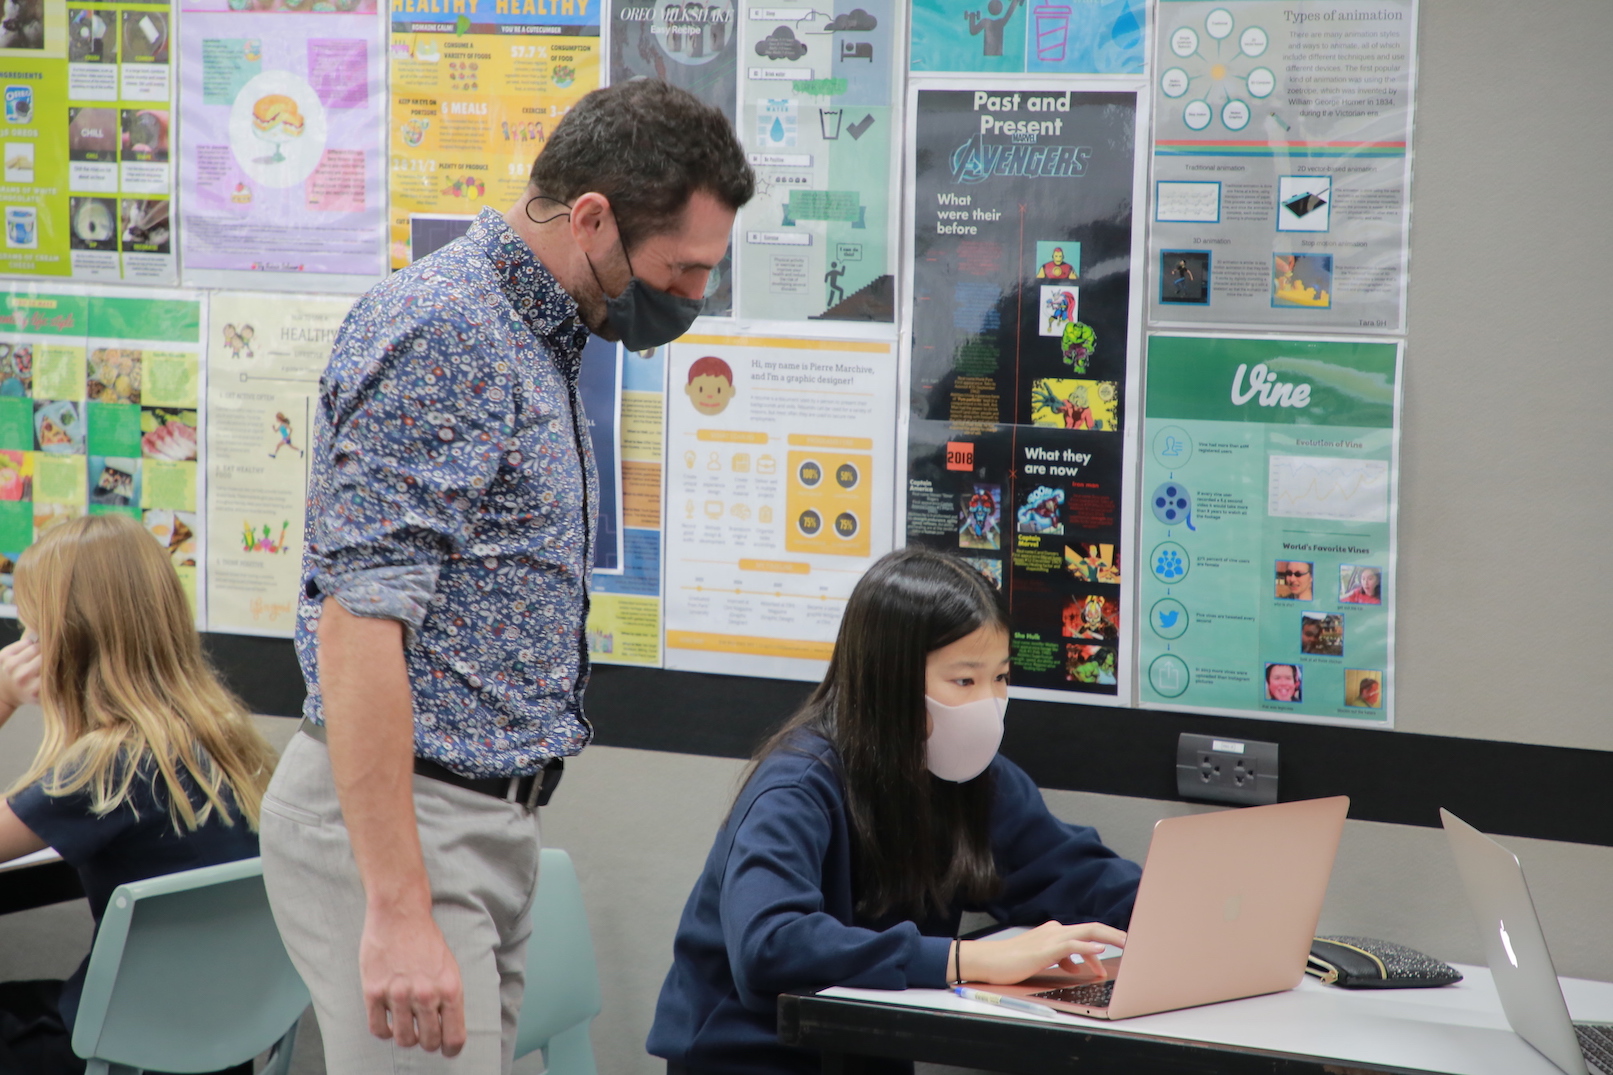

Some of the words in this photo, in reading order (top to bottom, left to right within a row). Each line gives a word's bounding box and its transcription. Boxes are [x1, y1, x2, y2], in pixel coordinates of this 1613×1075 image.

[496, 0, 588, 15] HEALTHY
[620, 8, 655, 21] OREO
[1283, 10, 1320, 24] Types
[1323, 9, 1337, 21] of
[1338, 9, 1403, 21] animation
[651, 25, 670, 36] Easy
[672, 25, 701, 36] Recipe
[1290, 31, 1309, 39] There
[1344, 31, 1378, 39] animation
[1380, 31, 1401, 40] styles
[1309, 53, 1336, 61] different
[1338, 54, 1376, 62] techniques
[1374, 64, 1401, 73] popular
[1388, 88, 1398, 96] by
[974, 91, 1020, 112] Past
[1027, 90, 1070, 112] and
[1315, 98, 1340, 106] George
[441, 102, 448, 114] 6
[451, 102, 488, 114] MEALS
[1300, 110, 1322, 118] during
[1336, 110, 1366, 118] Victorian
[980, 115, 1062, 136] Present
[81, 128, 104, 138] CHILL
[1012, 133, 1037, 144] MARVEL
[949, 133, 1093, 185] AVENGERS
[937, 193, 972, 206] What
[937, 210, 968, 221] were
[972, 208, 1002, 222] their
[937, 222, 978, 236] before
[1302, 240, 1315, 248] Stop
[1358, 320, 1374, 328] Tara
[281, 327, 338, 342] HEALTHY
[751, 360, 764, 370] Hi,
[764, 362, 776, 371] my
[778, 362, 800, 370] name
[802, 362, 808, 370] is
[810, 362, 834, 372] Pierre
[835, 364, 876, 375] Marchive,
[750, 372, 766, 380] and
[766, 373, 780, 381] I'm
[786, 375, 816, 384] graphic
[816, 376, 854, 386] designer!
[1230, 363, 1312, 408] Vine
[1296, 438, 1334, 448] Evolution
[1335, 439, 1345, 448] of
[1345, 440, 1364, 449] Vine
[948, 451, 973, 464] 2018
[1024, 446, 1060, 462] What
[1062, 448, 1092, 468] they
[1024, 464, 1047, 475] are
[1049, 465, 1079, 477] now
[1282, 542, 1312, 551] World's
[1313, 544, 1347, 553] Favorite
[1347, 546, 1370, 554] Vines
